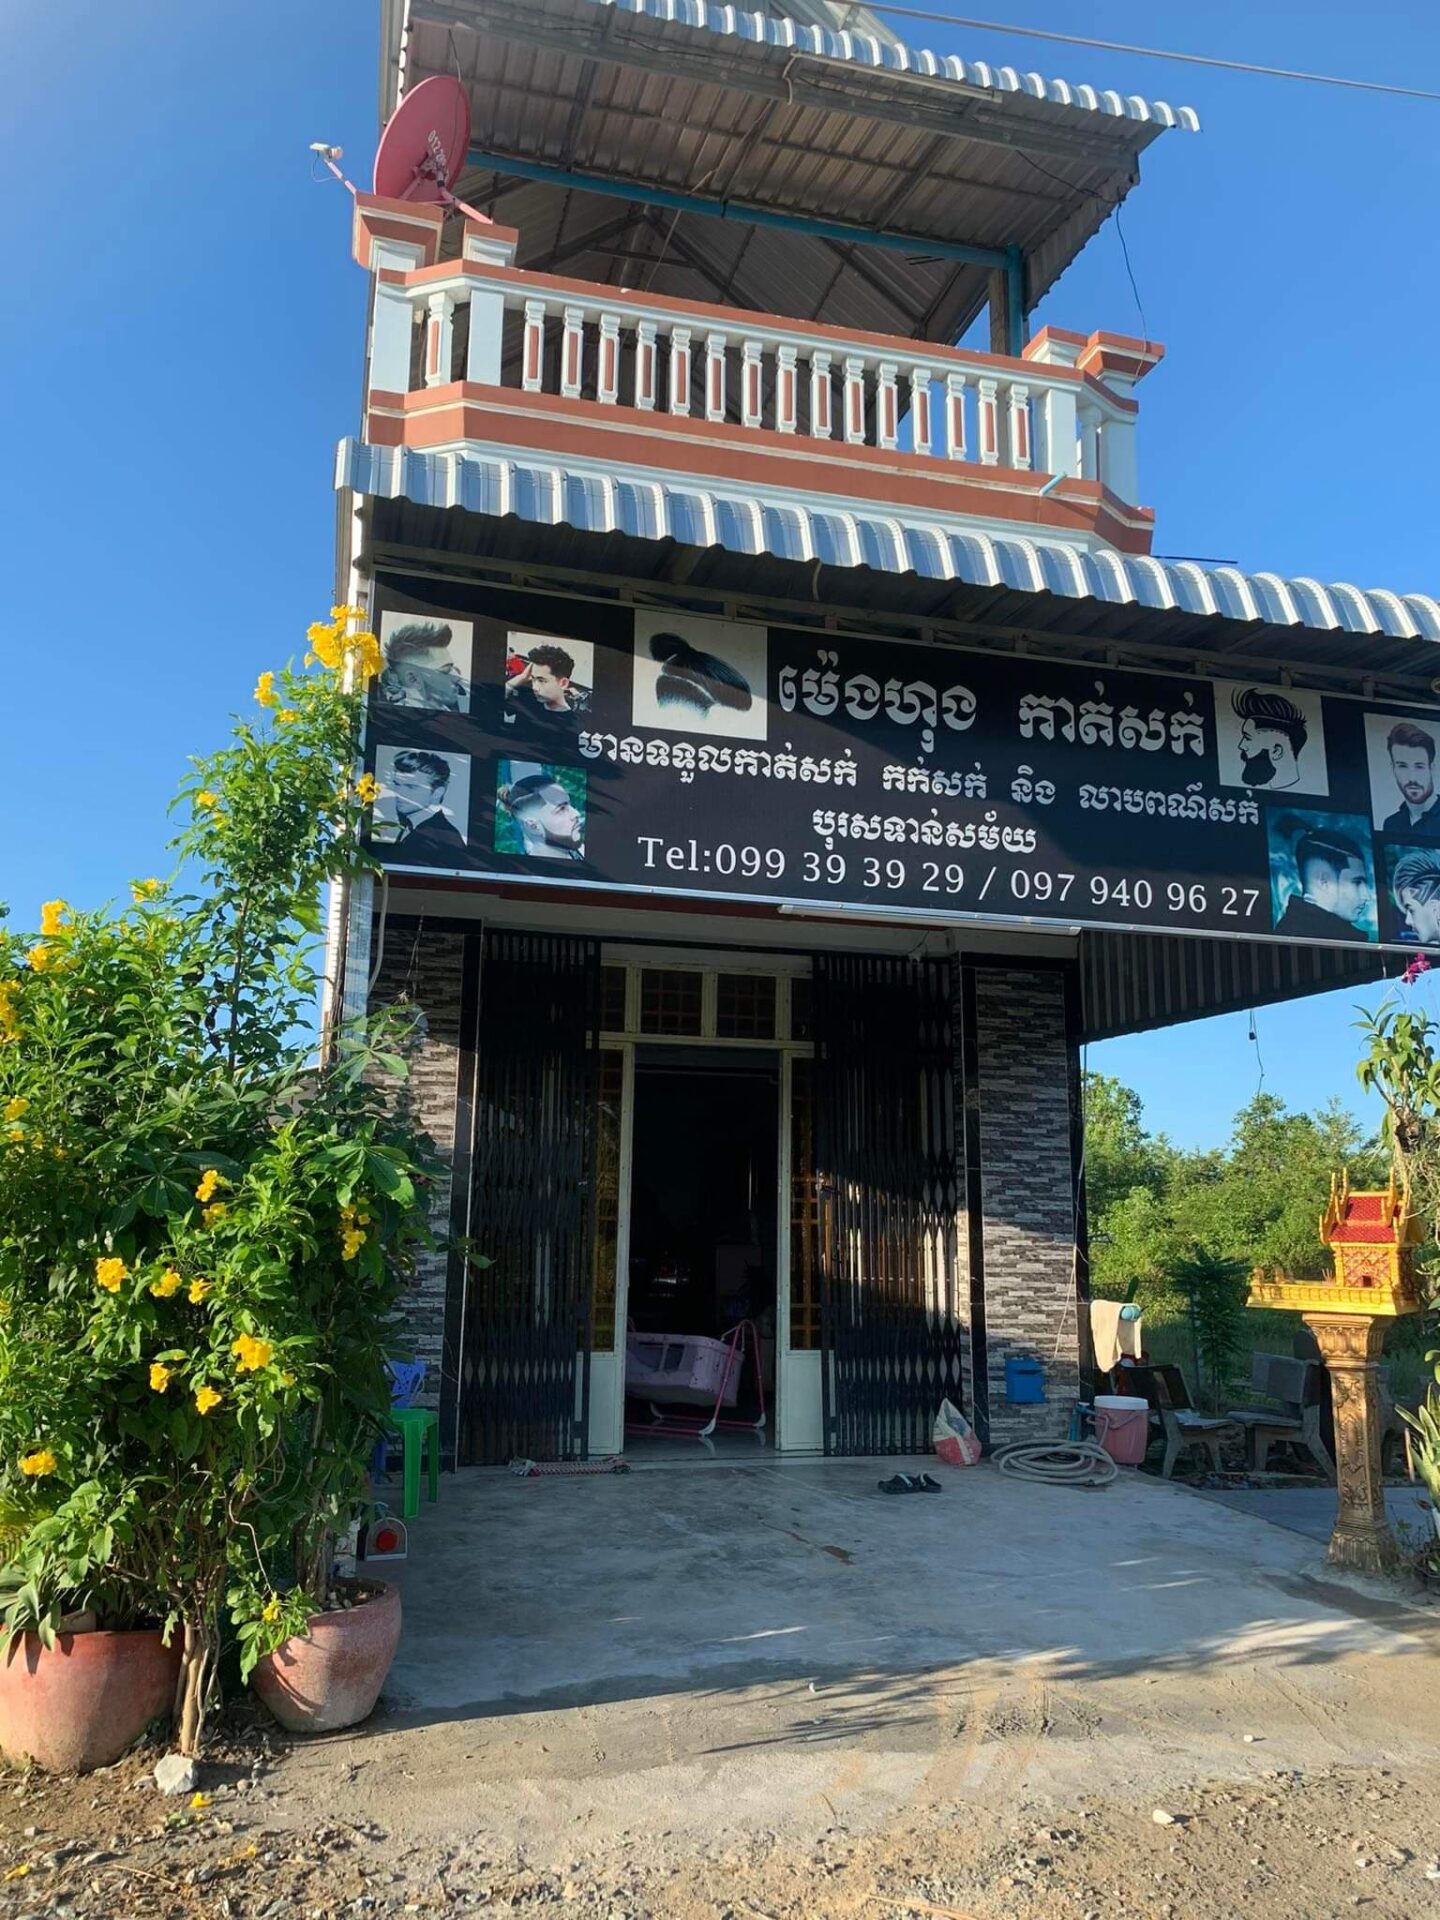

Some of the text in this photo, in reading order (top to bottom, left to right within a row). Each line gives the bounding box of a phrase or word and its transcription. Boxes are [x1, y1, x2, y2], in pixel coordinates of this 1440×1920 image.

[1018, 680, 1205, 757] កាត់សក់
[578, 730, 858, 787] មានទទួលកាត់សក់
[882, 755, 988, 799] កក់សក់
[1010, 764, 1056, 805] និង
[812, 808, 1037, 854] បុរសទាន់សម័យ
[637, 836, 1260, 917] Tel:099 39 39 29 / 097 940 96 27
